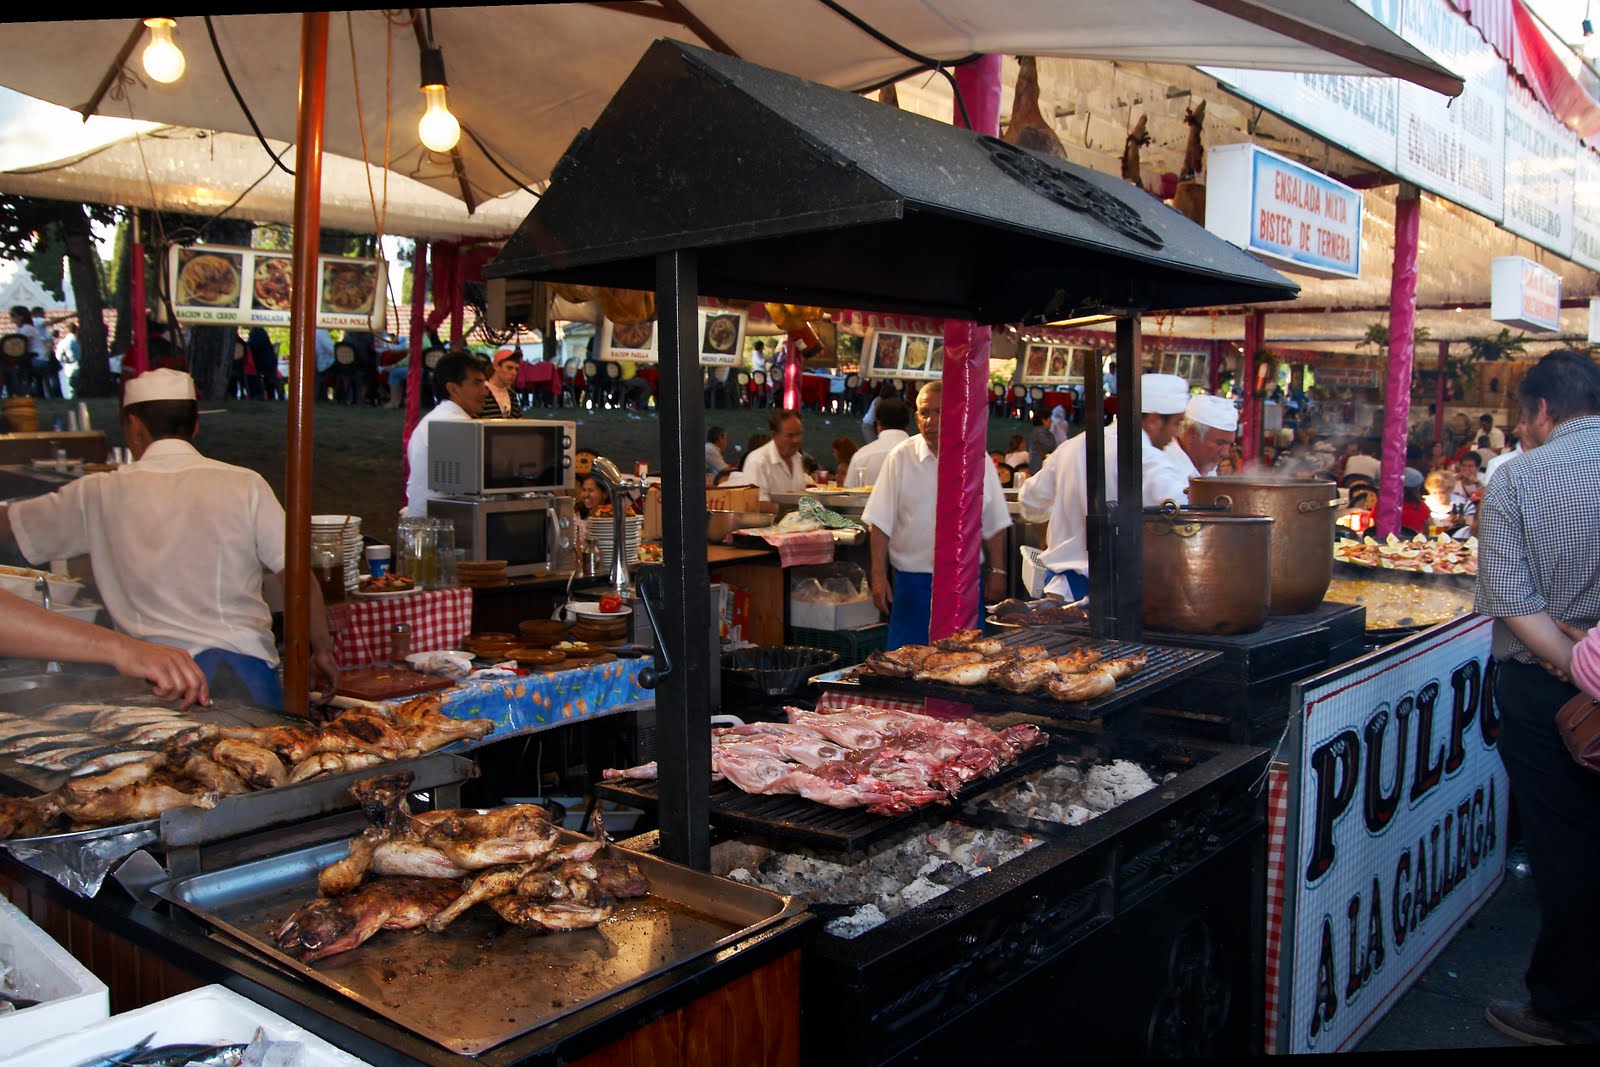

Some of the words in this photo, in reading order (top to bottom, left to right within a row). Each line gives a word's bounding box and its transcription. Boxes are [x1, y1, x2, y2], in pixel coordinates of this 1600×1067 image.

[1275, 170, 1320, 214] ENSALADA
[1324, 191, 1347, 224] MIXTA
[1259, 208, 1292, 246] BISTEC
[1299, 220, 1311, 252] DE
[1317, 227, 1351, 263] TERNERA
[321, 317, 348, 325] ALITAS
[1310, 917, 1338, 1038] A
[1345, 875, 1386, 1002] LA
[1393, 776, 1497, 947] GALLEGA
